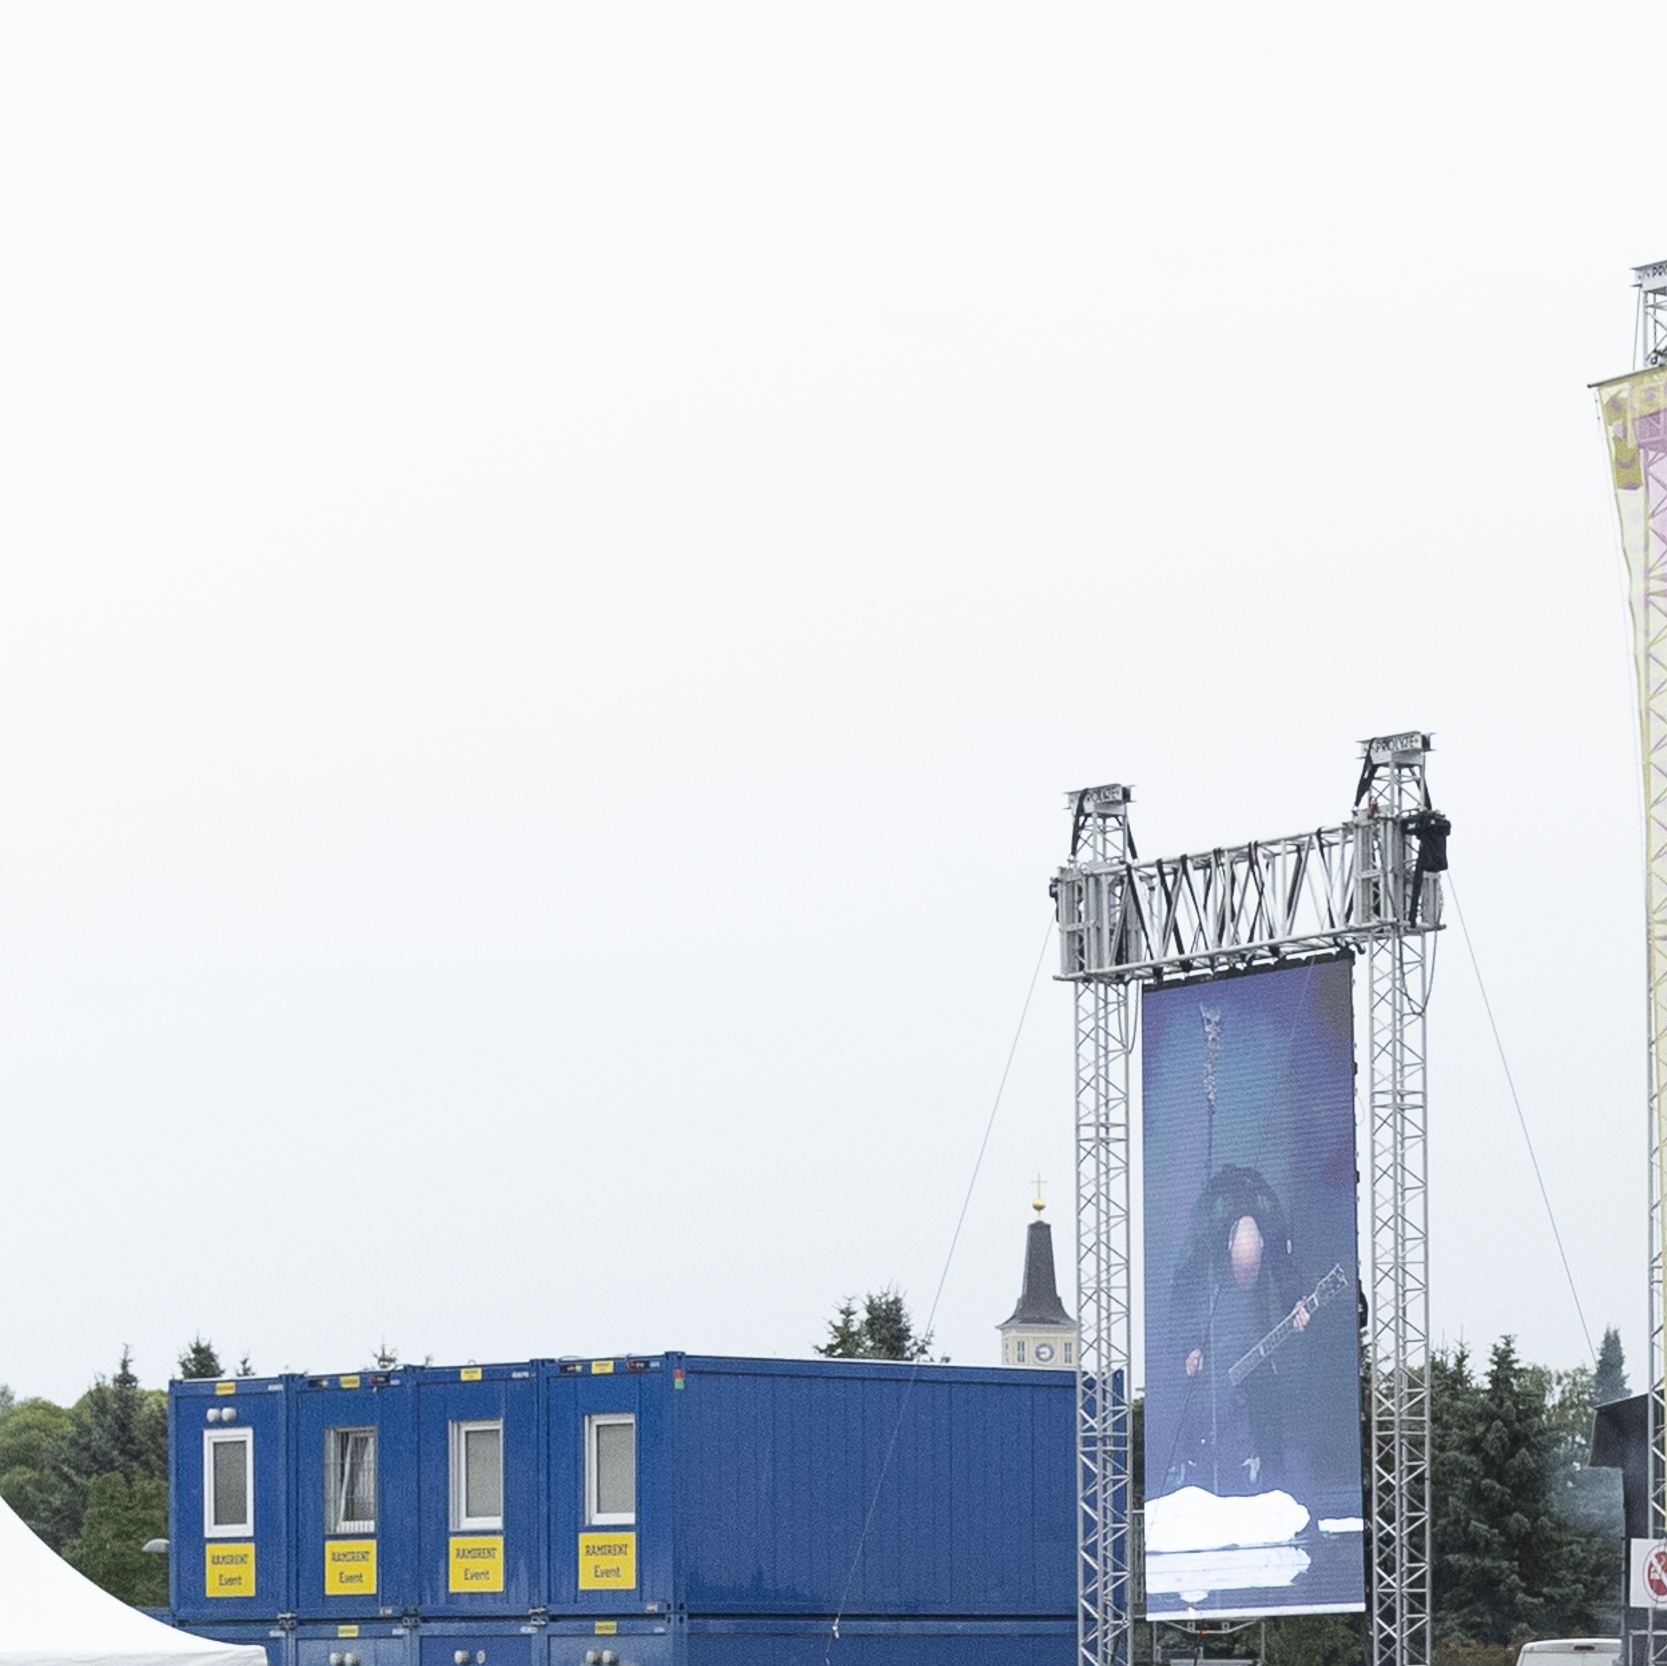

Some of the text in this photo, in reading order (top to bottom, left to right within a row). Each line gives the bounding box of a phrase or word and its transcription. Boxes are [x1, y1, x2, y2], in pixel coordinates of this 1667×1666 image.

[338, 1571, 363, 1584] Event
[463, 1568, 490, 1581] Event
[594, 1565, 621, 1578] Event
[218, 1573, 242, 1586] Event
